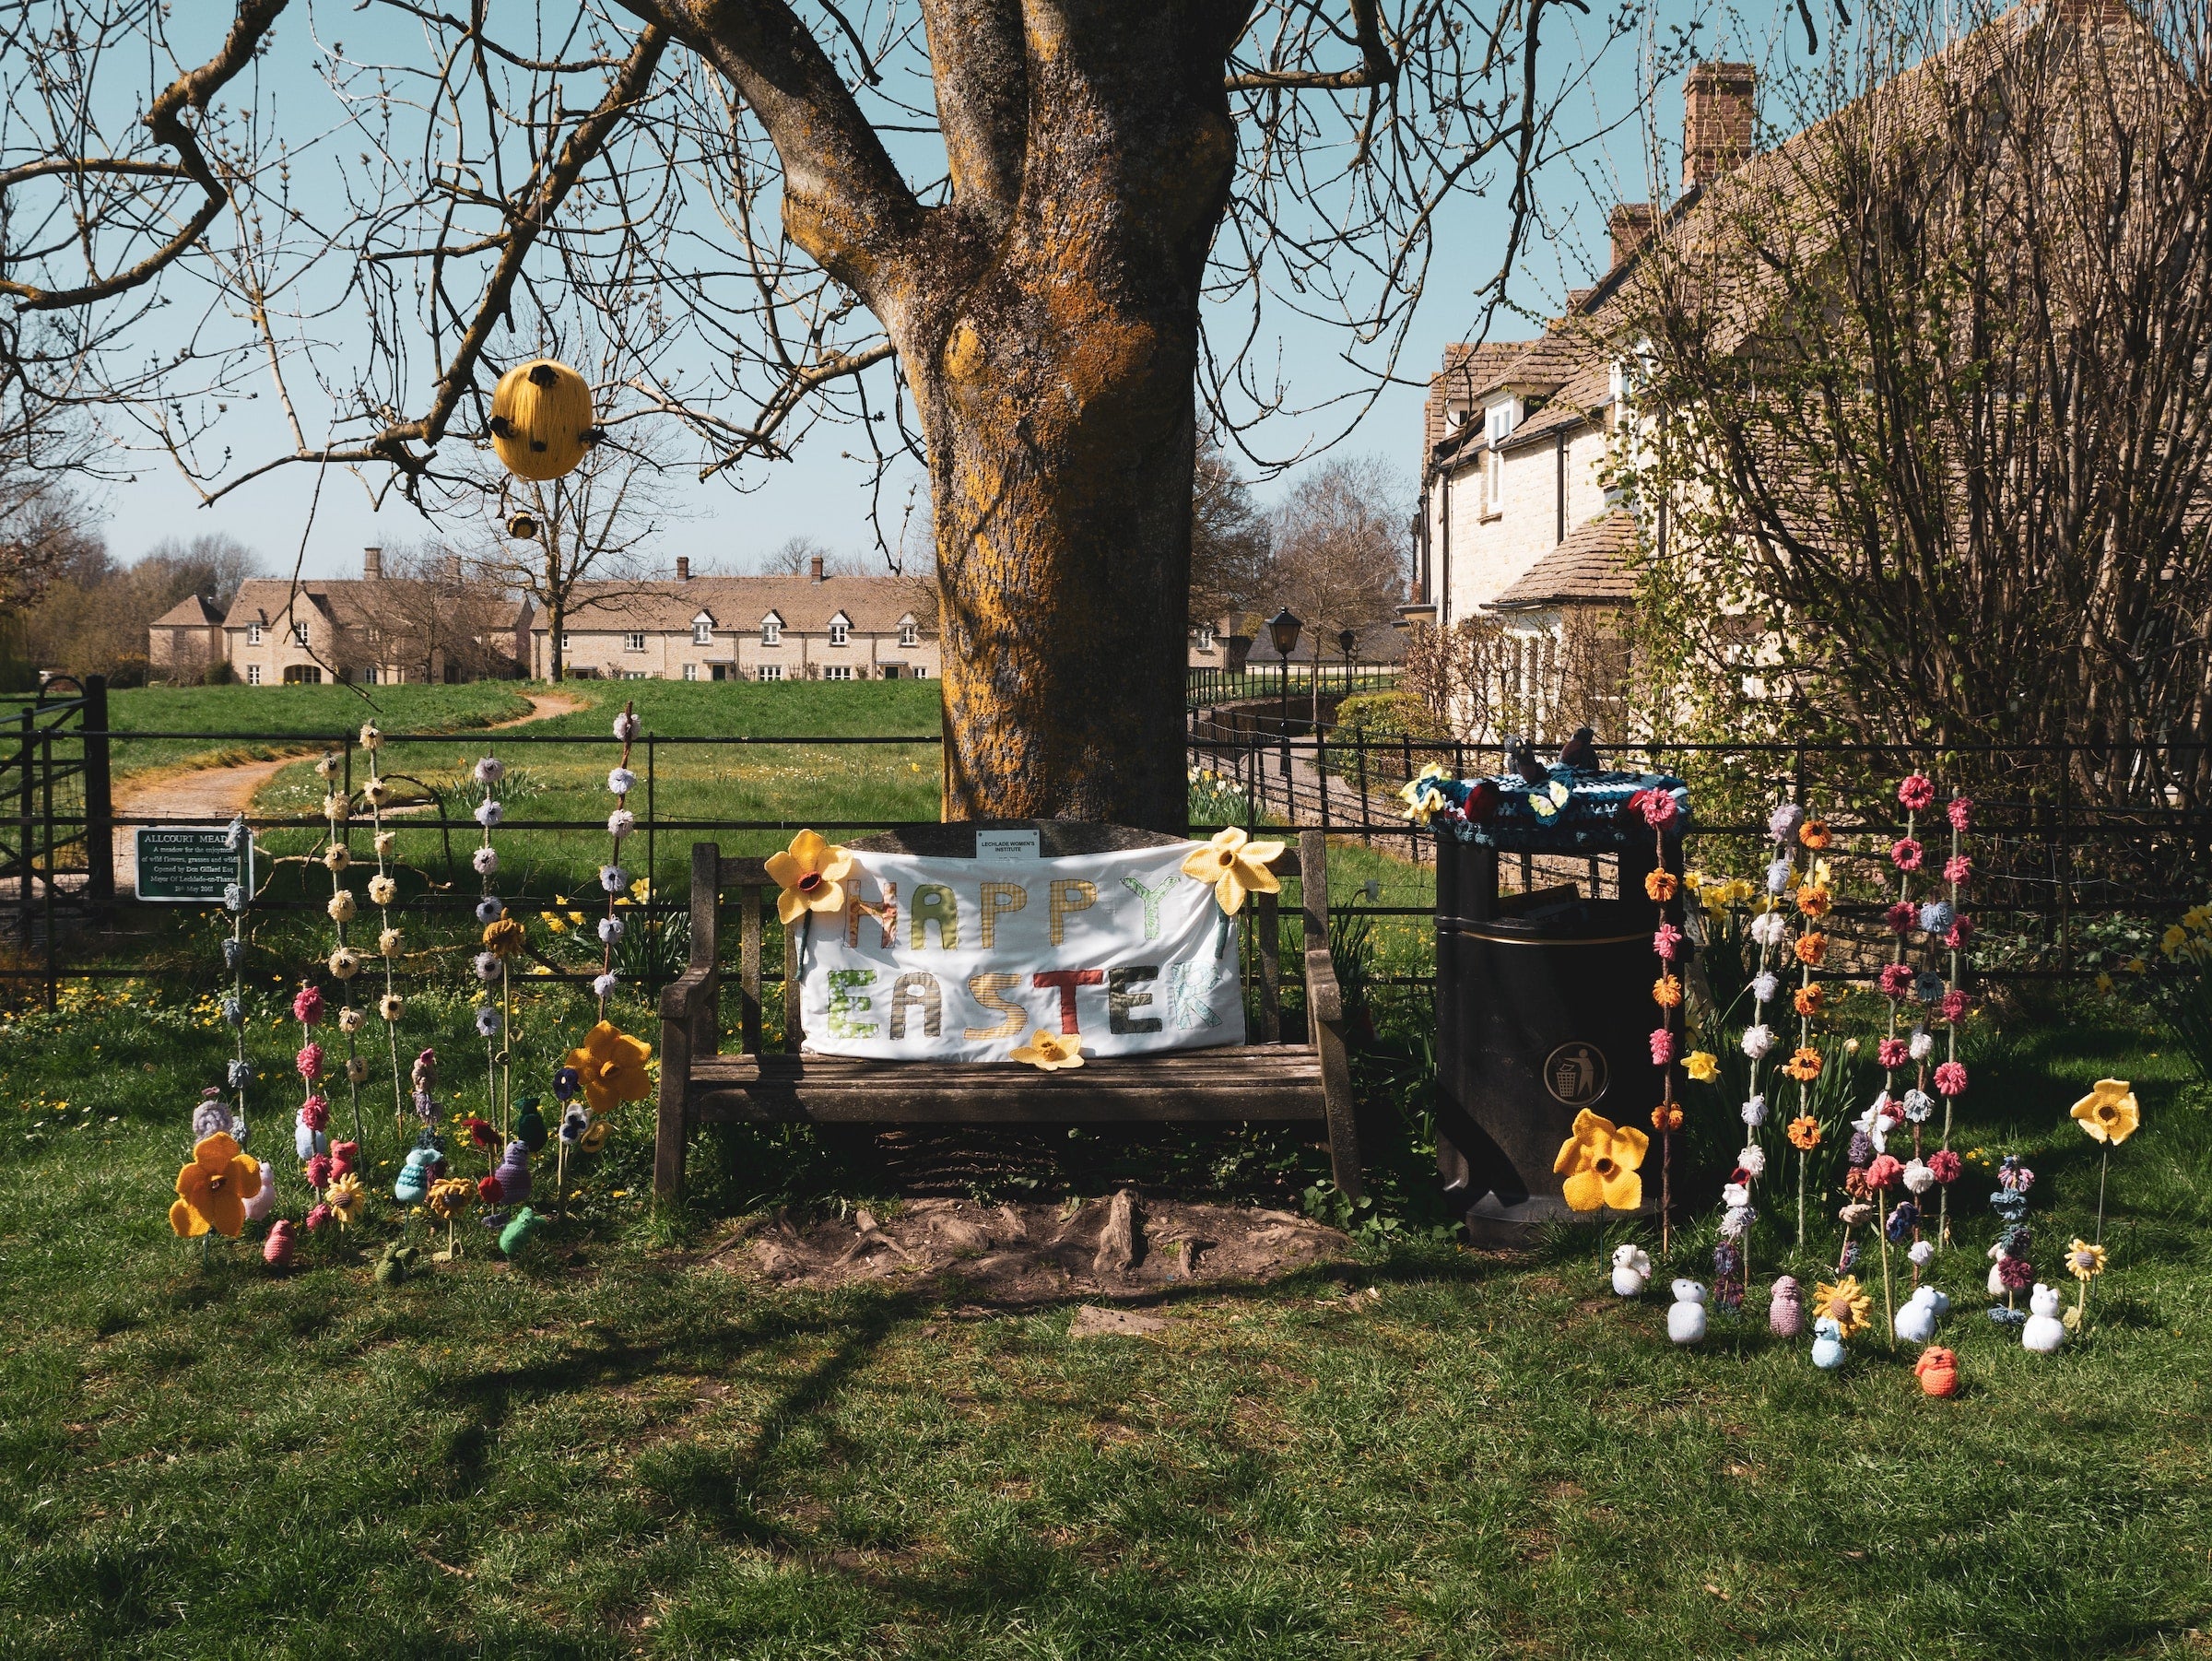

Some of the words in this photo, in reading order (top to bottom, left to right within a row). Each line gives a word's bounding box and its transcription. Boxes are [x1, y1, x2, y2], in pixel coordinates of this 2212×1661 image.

[144, 834, 194, 842] ALLCOURT
[199, 834, 229, 842] MEAD
[222, 866, 234, 874] Esq
[843, 876, 1182, 951] HAPPY
[828, 960, 1222, 1041] EASTER
